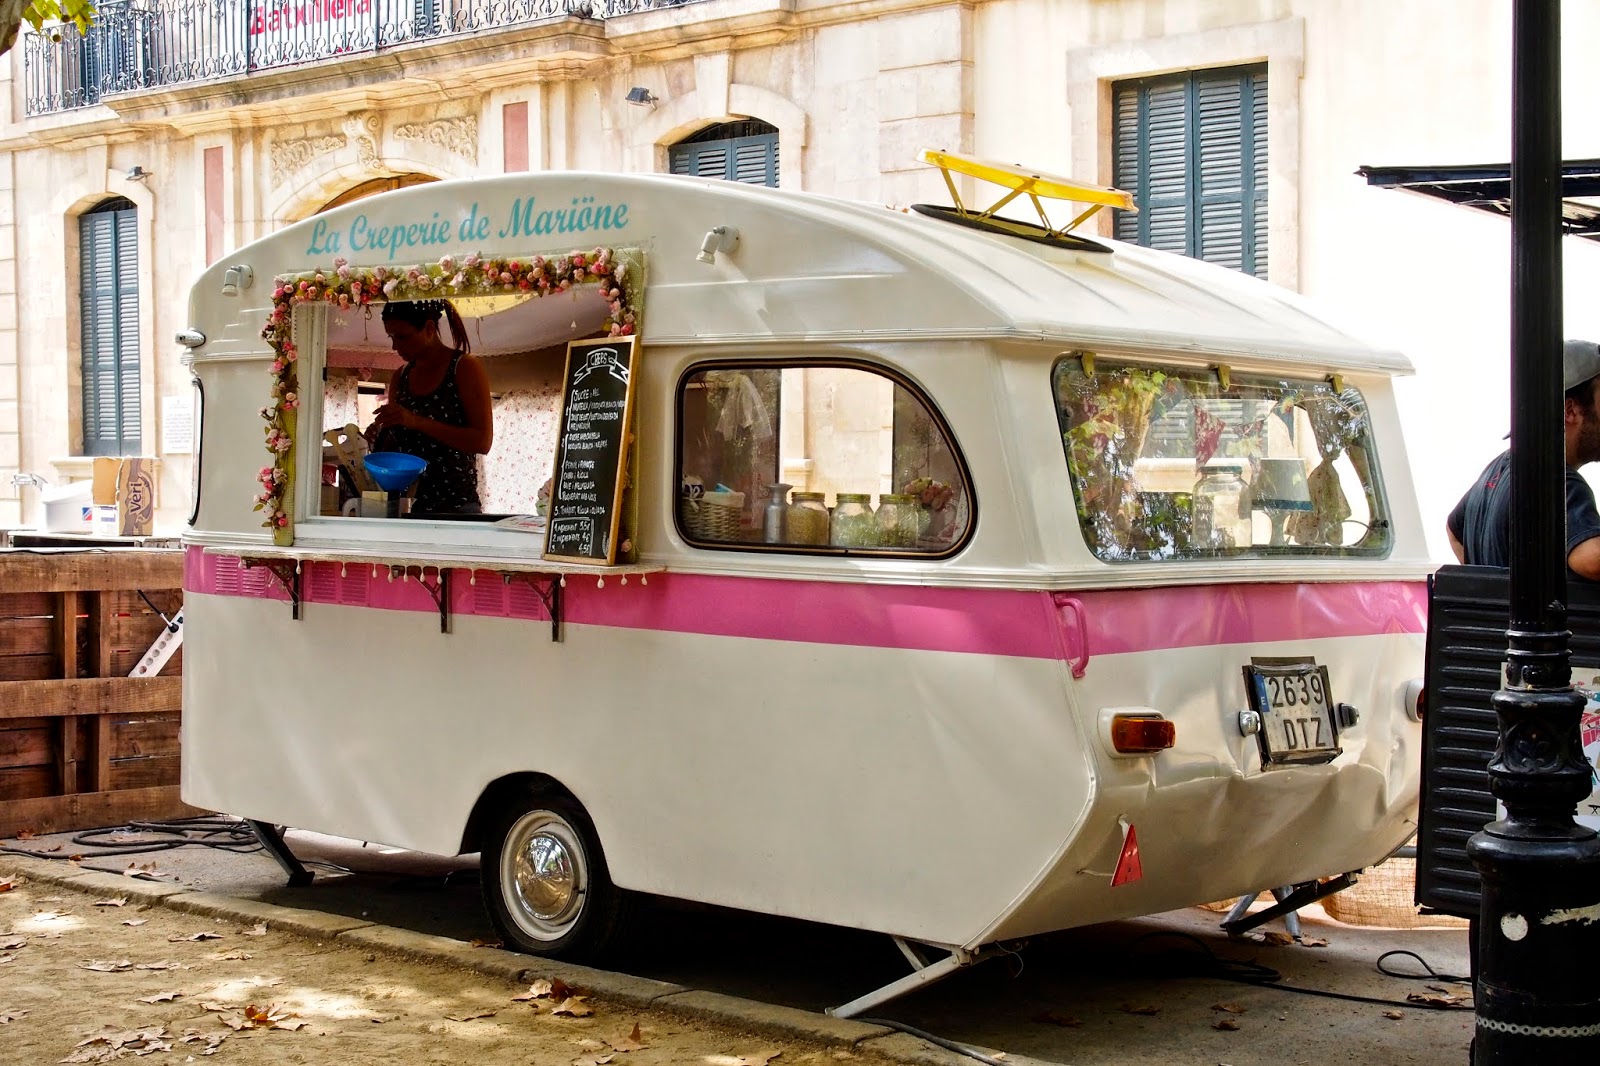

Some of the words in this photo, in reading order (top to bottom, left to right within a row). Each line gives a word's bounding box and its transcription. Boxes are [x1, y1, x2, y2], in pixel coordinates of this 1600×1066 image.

[306, 218, 342, 256] La
[349, 214, 452, 261] Creperie
[459, 202, 491, 243] de
[498, 196, 630, 238] Mariöne
[130, 482, 142, 513] Veri
[1268, 674, 1324, 708] 2639
[1283, 717, 1326, 750] DTZ
